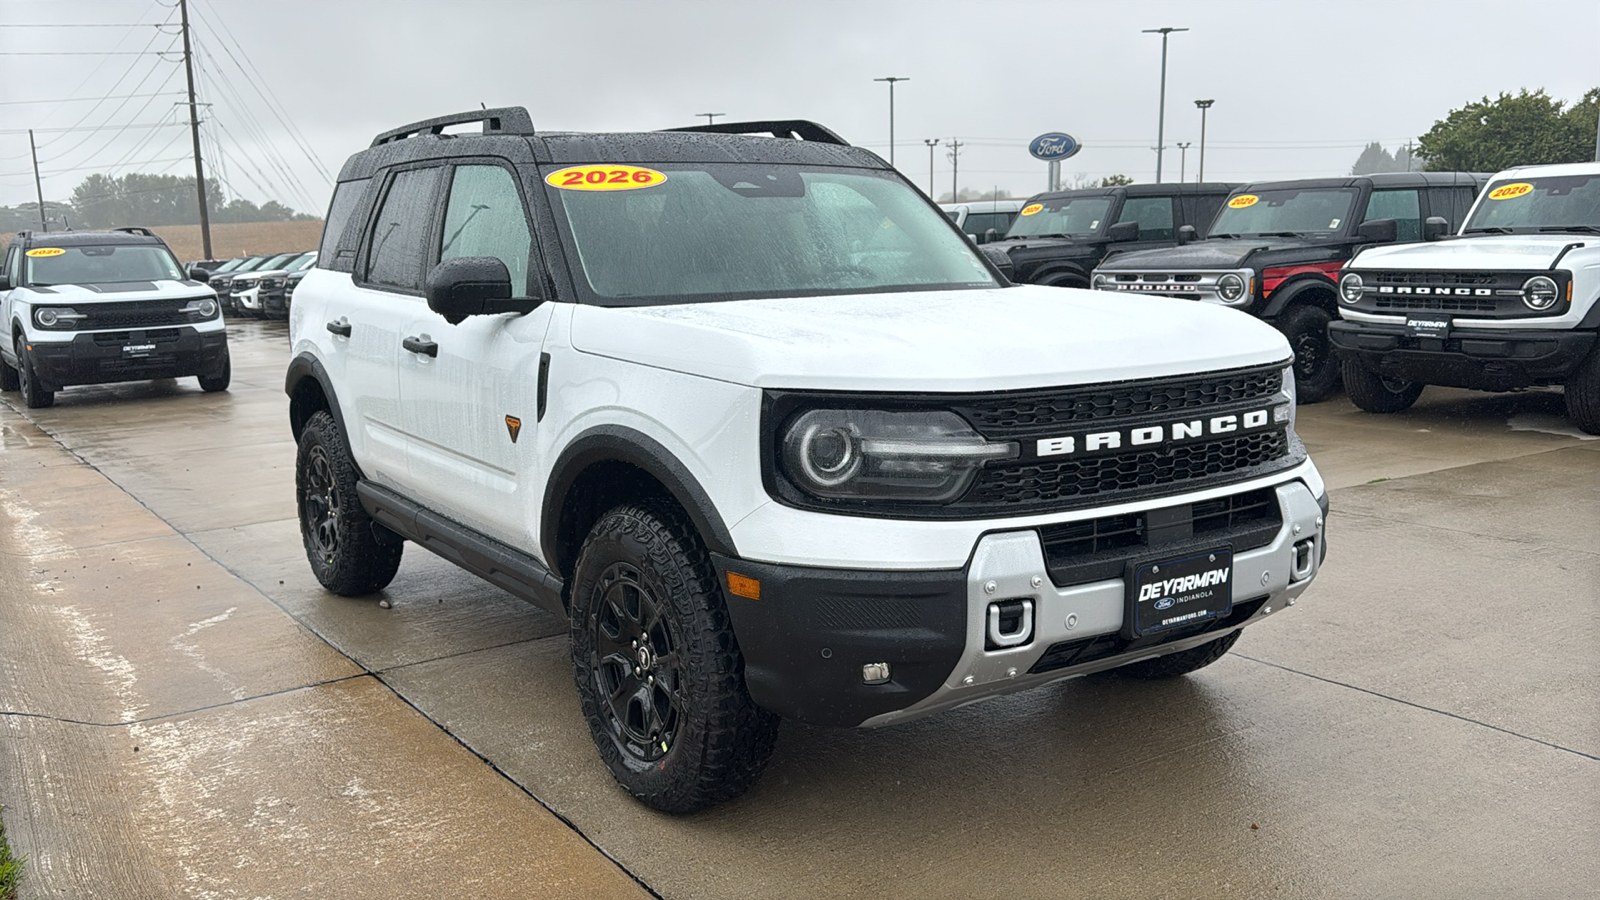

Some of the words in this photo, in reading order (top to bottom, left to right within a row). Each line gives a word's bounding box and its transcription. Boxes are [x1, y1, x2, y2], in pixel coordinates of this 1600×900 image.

[1037, 137, 1067, 156] Ford
[561, 170, 653, 186] 2026
[1492, 185, 1529, 198] 2026
[1379, 286, 1492, 296] BRONCO
[1407, 319, 1448, 329] DEYARMAN
[1036, 409, 1268, 457] BRONCO
[1138, 567, 1230, 602] DEYARMAN
[1176, 590, 1214, 604] INDIANOLA
[1162, 609, 1207, 626] DEYARMANFORD.COM
